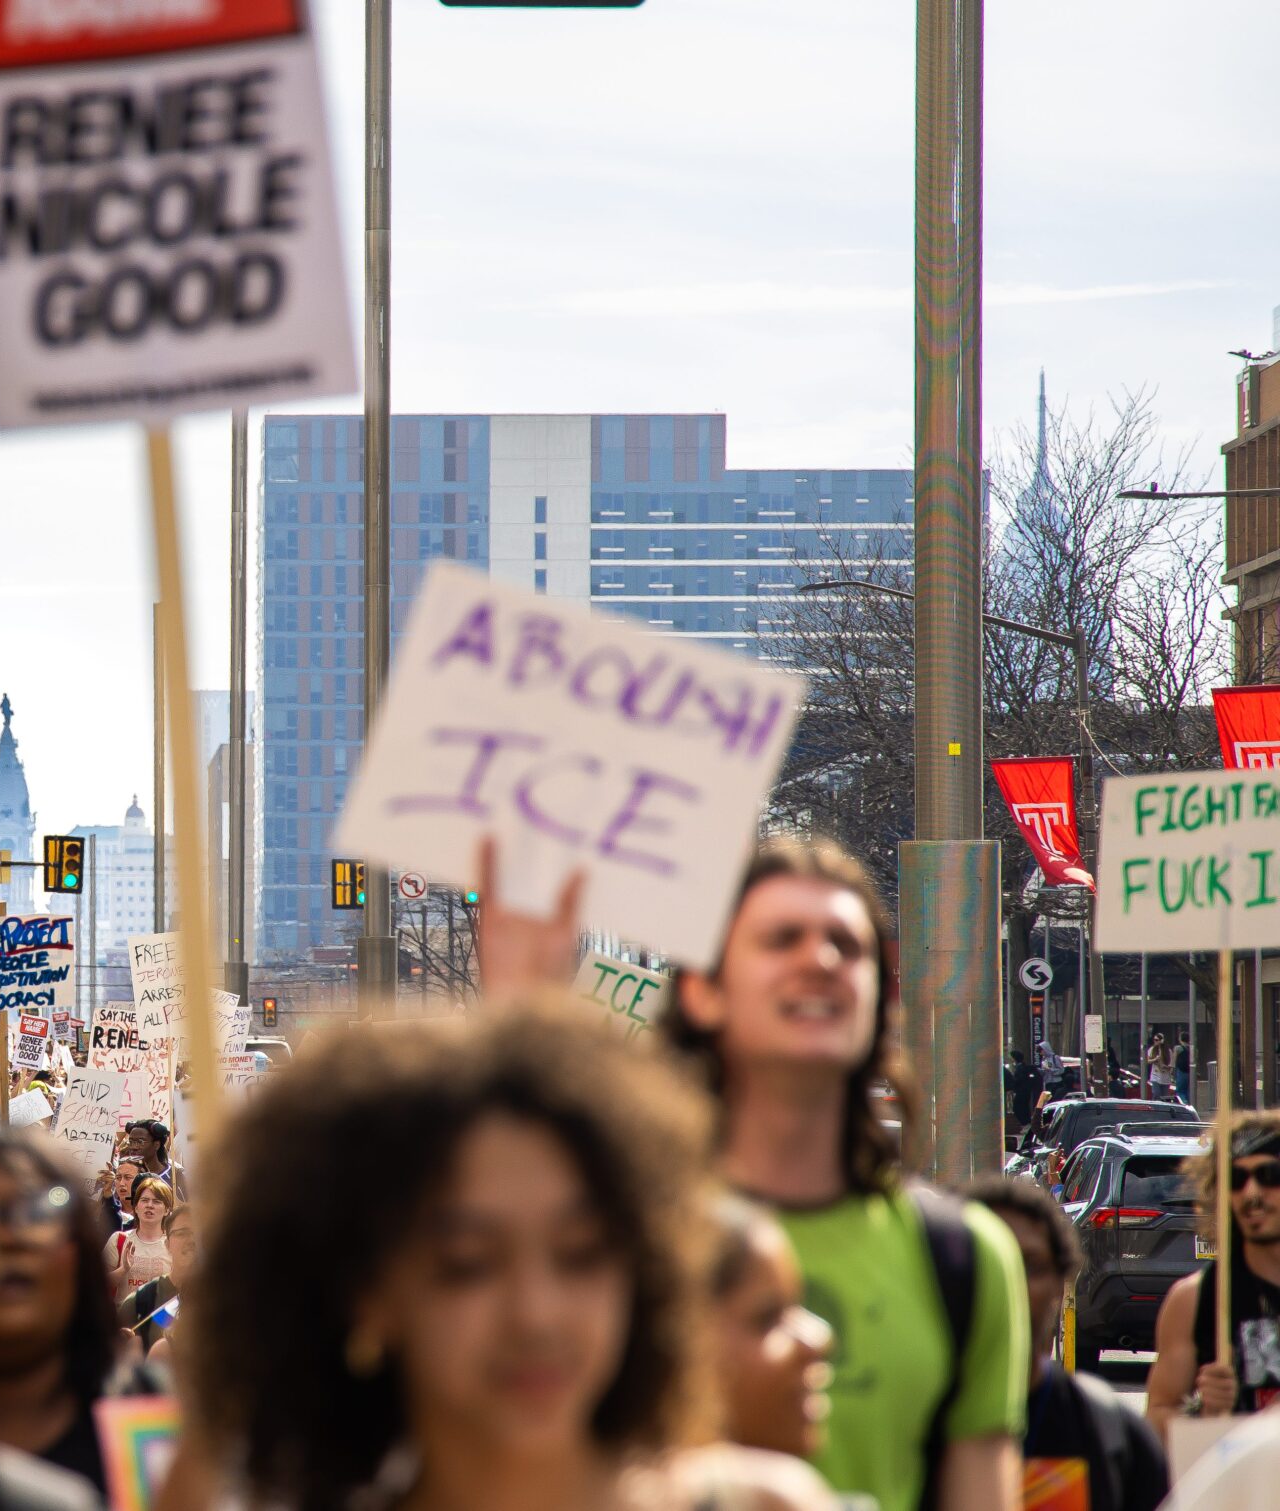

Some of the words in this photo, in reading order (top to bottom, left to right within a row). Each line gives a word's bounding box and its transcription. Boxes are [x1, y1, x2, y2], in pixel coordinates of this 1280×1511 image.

[0, 68, 280, 171] RENEE
[32, 249, 286, 347] GOOD
[430, 601, 784, 757] ABOLISH
[385, 728, 704, 877] ICE
[1134, 782, 1244, 836] FIGHT
[1122, 855, 1233, 915] FUCK
[134, 941, 176, 967] FREE
[139, 984, 187, 1007] ARREST
[579, 962, 661, 1024] ICE
[99, 1009, 118, 1022] SAY
[143, 1012, 163, 1029] ALL
[21, 1035, 43, 1045] RENEE
[25, 1026, 41, 1034] NAME
[18, 1043, 43, 1054] NICOLE
[18, 1052, 39, 1061] GOOD
[228, 1055, 253, 1064] MONEY
[68, 1079, 110, 1102] FUND
[60, 1102, 120, 1127] SCHOOLS
[58, 1128, 113, 1145] ABOLISH
